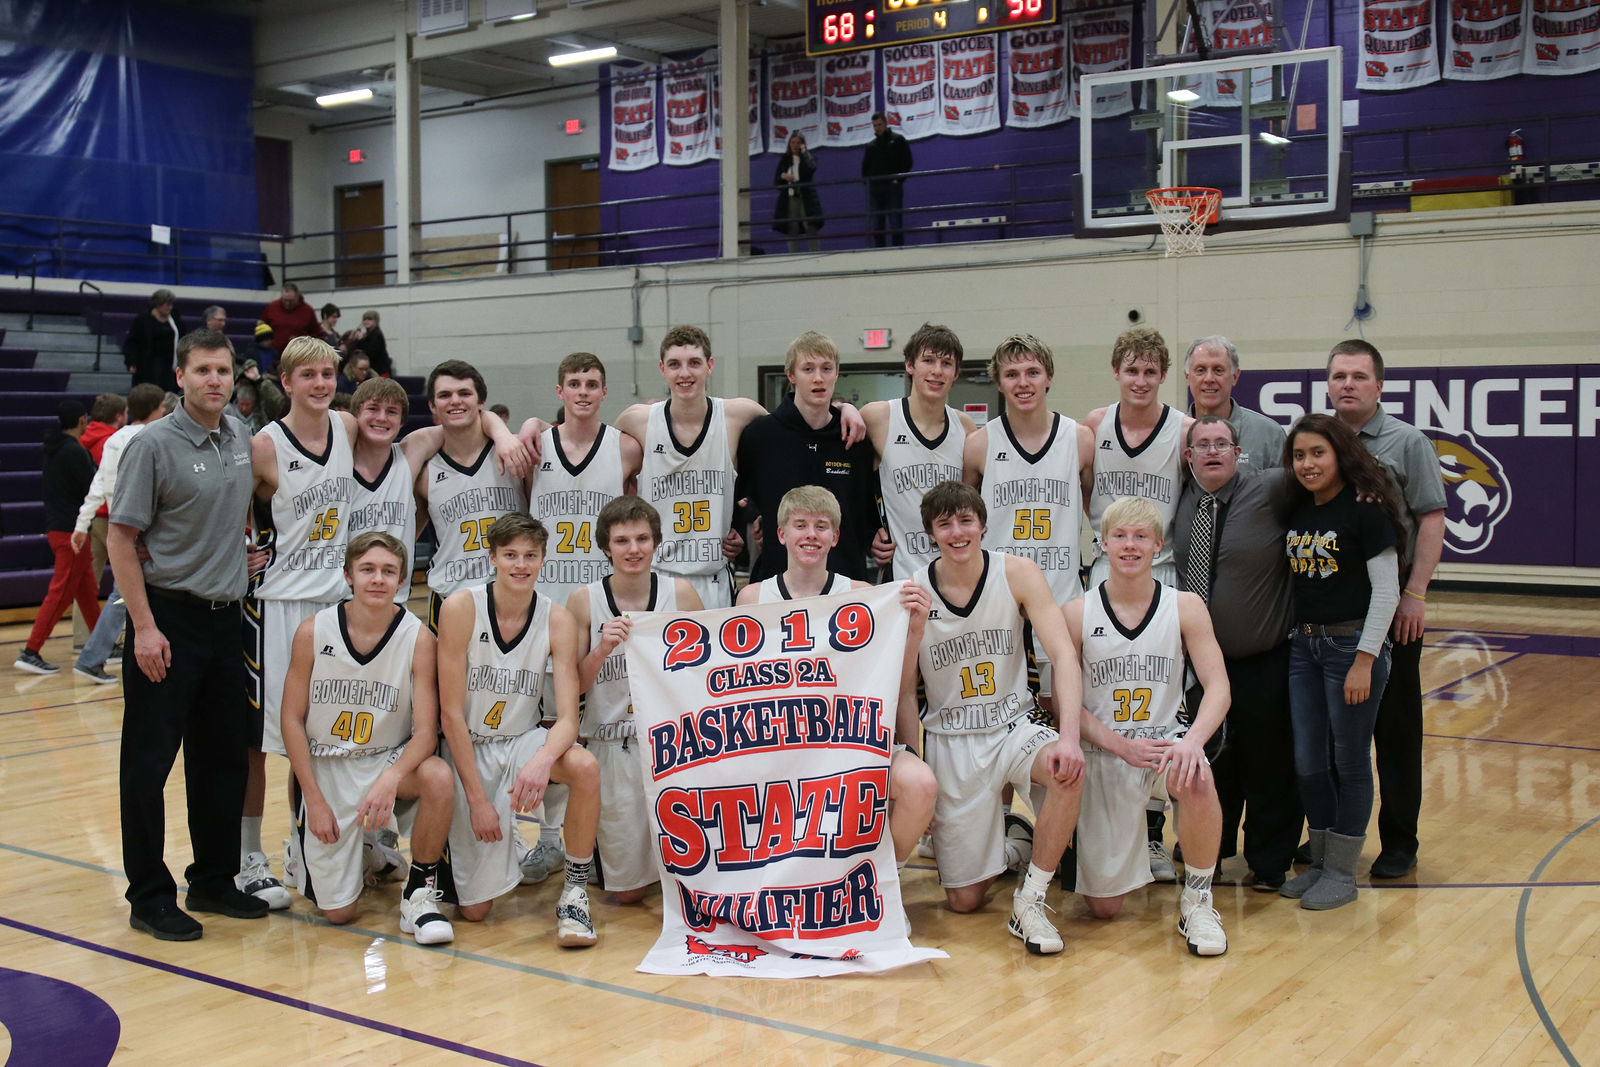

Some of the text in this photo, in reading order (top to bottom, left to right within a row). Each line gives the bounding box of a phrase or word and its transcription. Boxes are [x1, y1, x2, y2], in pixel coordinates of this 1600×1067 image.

[823, 12, 855, 44] 68
[896, 18, 930, 32] PERIOD
[934, 10, 947, 29] 4
[1364, 0, 1431, 32] STATE
[1452, 16, 1521, 45] QUALIFIER
[1533, 9, 1600, 38] QUALIFIE
[941, 36, 995, 57] SOCCER
[1010, 30, 1065, 50] GOLF
[1364, 27, 1432, 55] QUALIFIER
[825, 55, 870, 73] GOLF
[887, 60, 937, 87] STATE
[943, 53, 996, 81] STATE
[1011, 47, 1064, 75] STATE
[771, 75, 818, 101] STATE
[824, 71, 873, 98] STATE
[652, 470, 724, 502] BOYDEN-HUL
[893, 463, 962, 494] BOYDEN-HU
[994, 478, 1071, 508] BOYDEN-HULL
[439, 487, 517, 526] BOYDEN-HULL
[538, 490, 614, 520] BOYDEN-HU
[673, 500, 711, 533] 35
[309, 507, 339, 541] 15
[460, 517, 497, 552] 25
[556, 521, 591, 553] 24
[1013, 508, 1051, 540] 55
[656, 538, 724, 563] OMET
[1290, 558, 1339, 573] OMETS
[663, 602, 875, 672] 2019
[929, 629, 1014, 671] BOYDEN-HULL
[707, 657, 837, 697] CLASS 2A
[959, 661, 996, 700] 13
[311, 678, 399, 712] BOYDEN-HULL
[939, 692, 1021, 730] COMETS
[1113, 687, 1152, 722] 32
[330, 710, 374, 745] 40
[483, 700, 507, 729] 4
[648, 694, 892, 782] BASKETBALL
[655, 766, 890, 876] STATE
[675, 858, 884, 941] QUALIFIER
